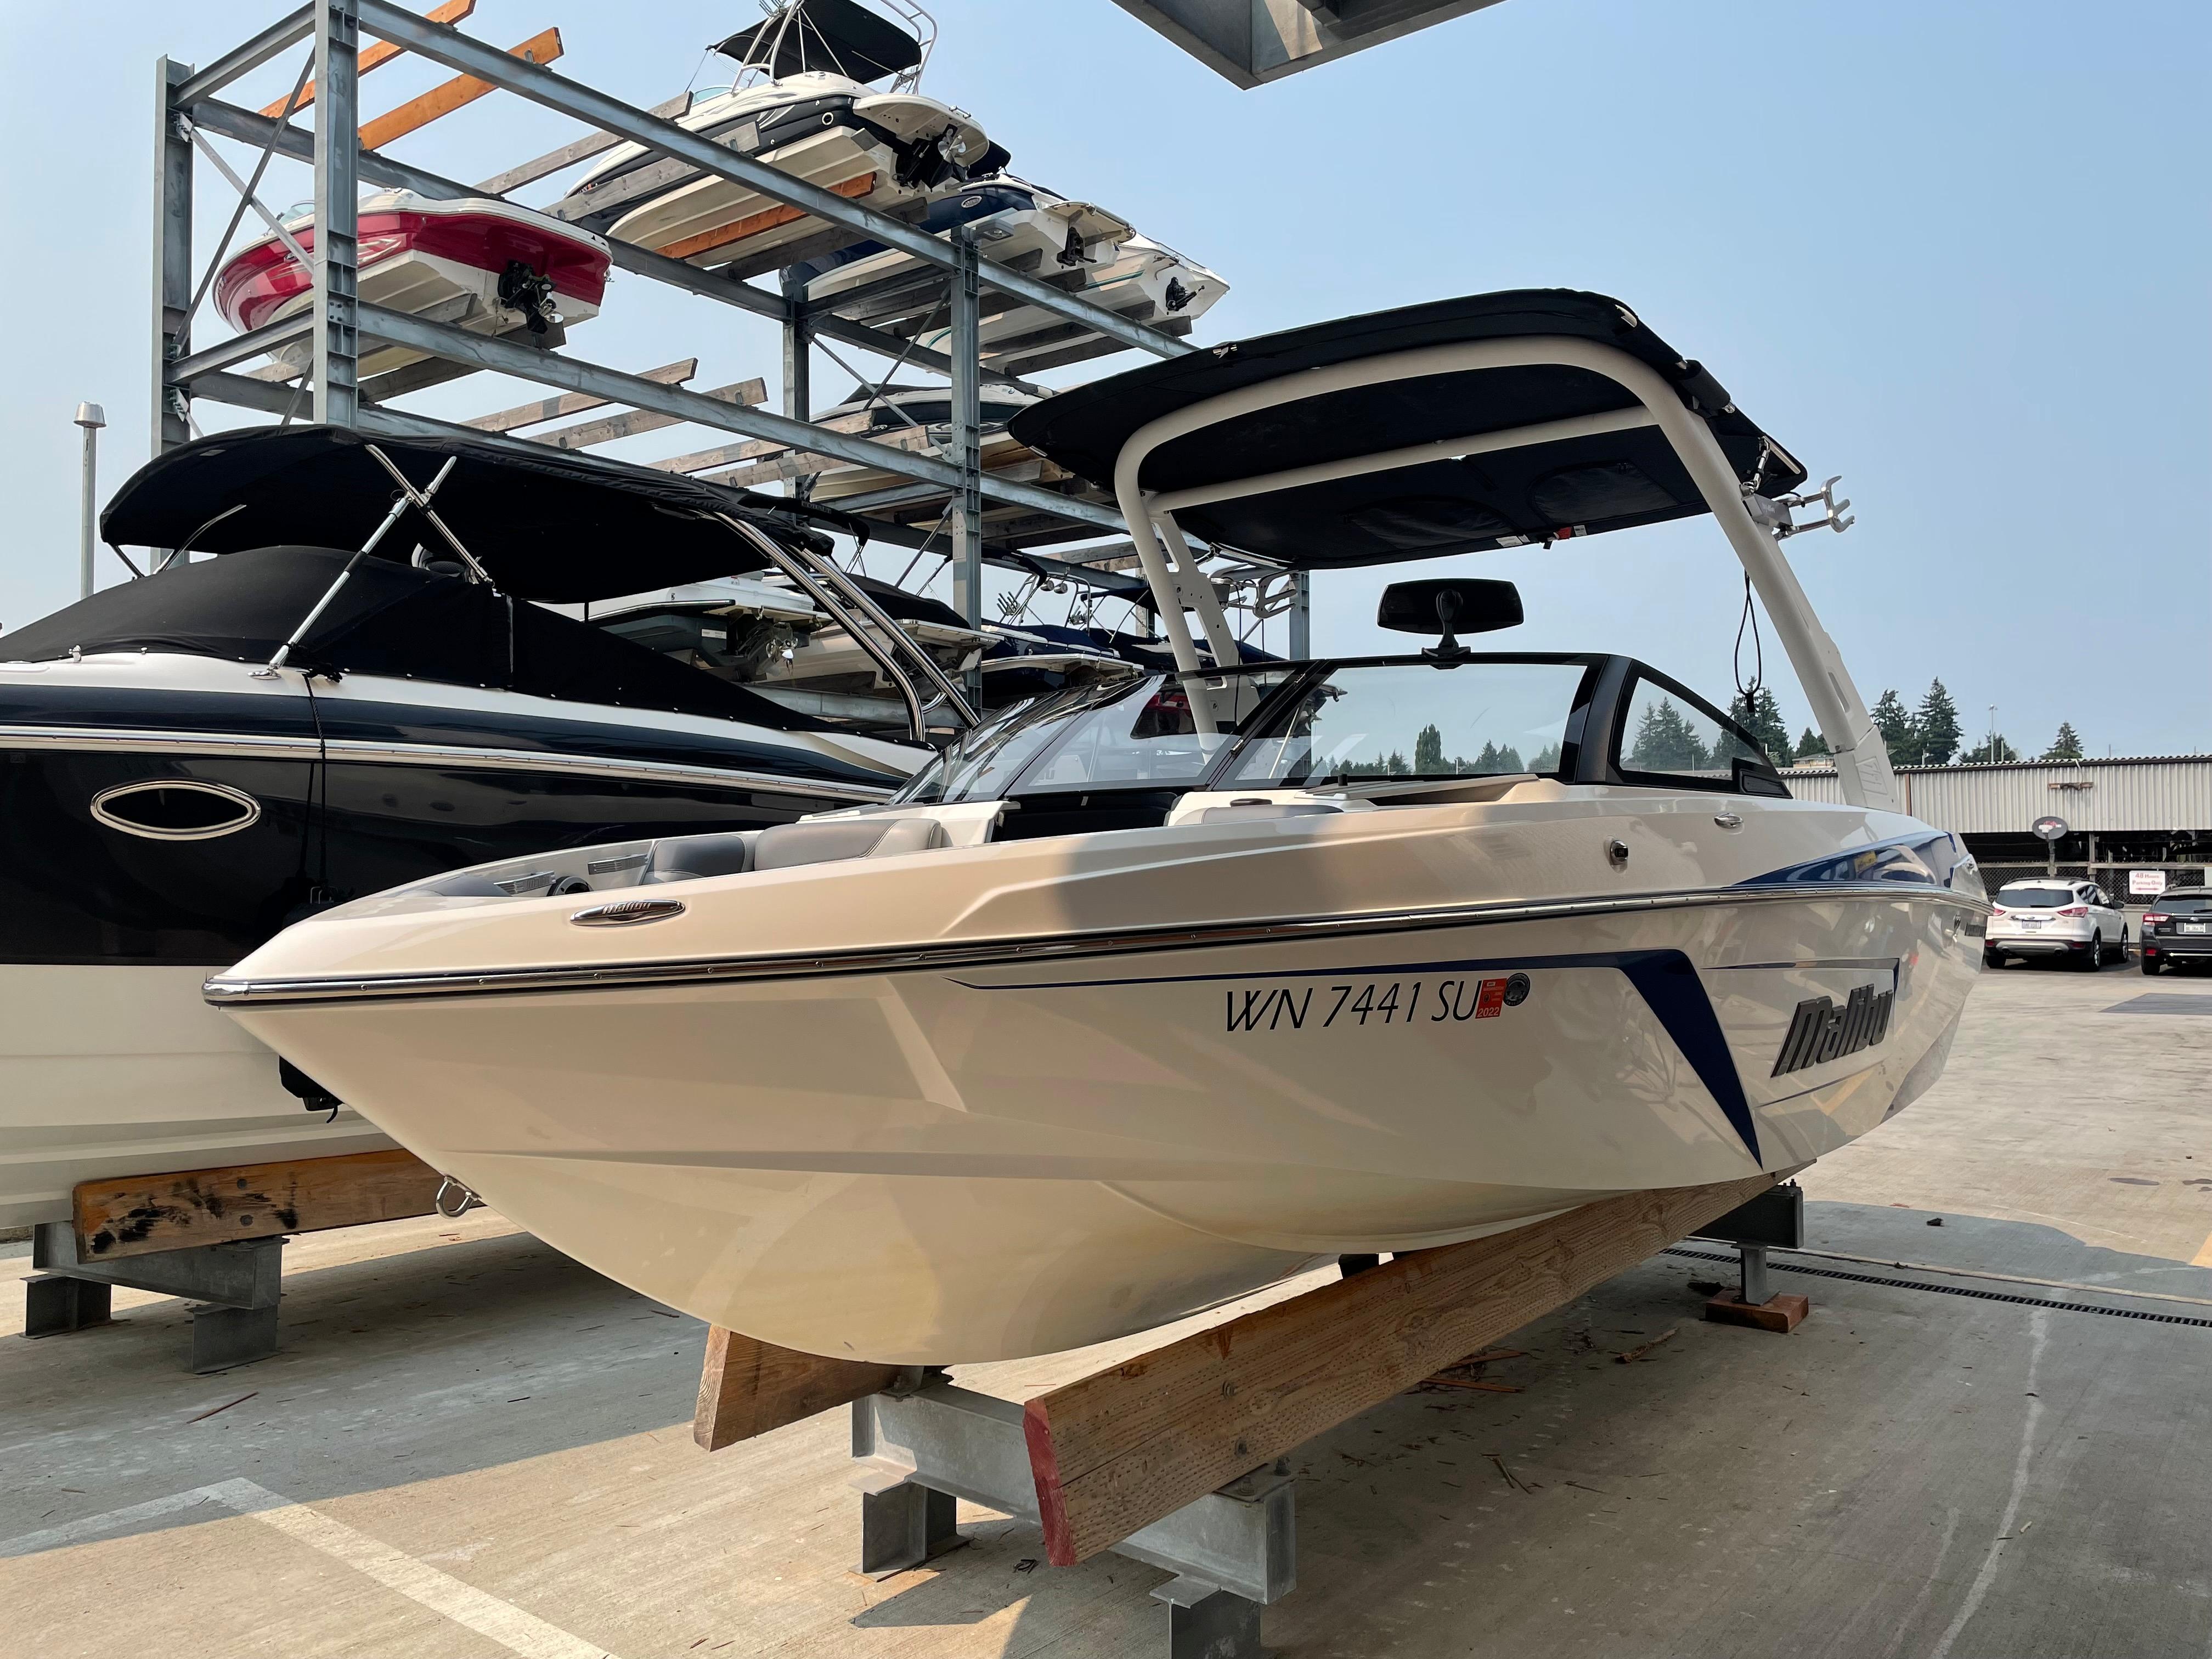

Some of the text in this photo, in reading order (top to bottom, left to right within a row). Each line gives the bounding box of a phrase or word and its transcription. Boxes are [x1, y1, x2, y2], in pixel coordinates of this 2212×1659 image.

[1227, 988, 1313, 1031] WN
[1323, 982, 1421, 1027] 7441
[1431, 980, 1482, 1022] SU
[1477, 1007, 1499, 1018] 2022
